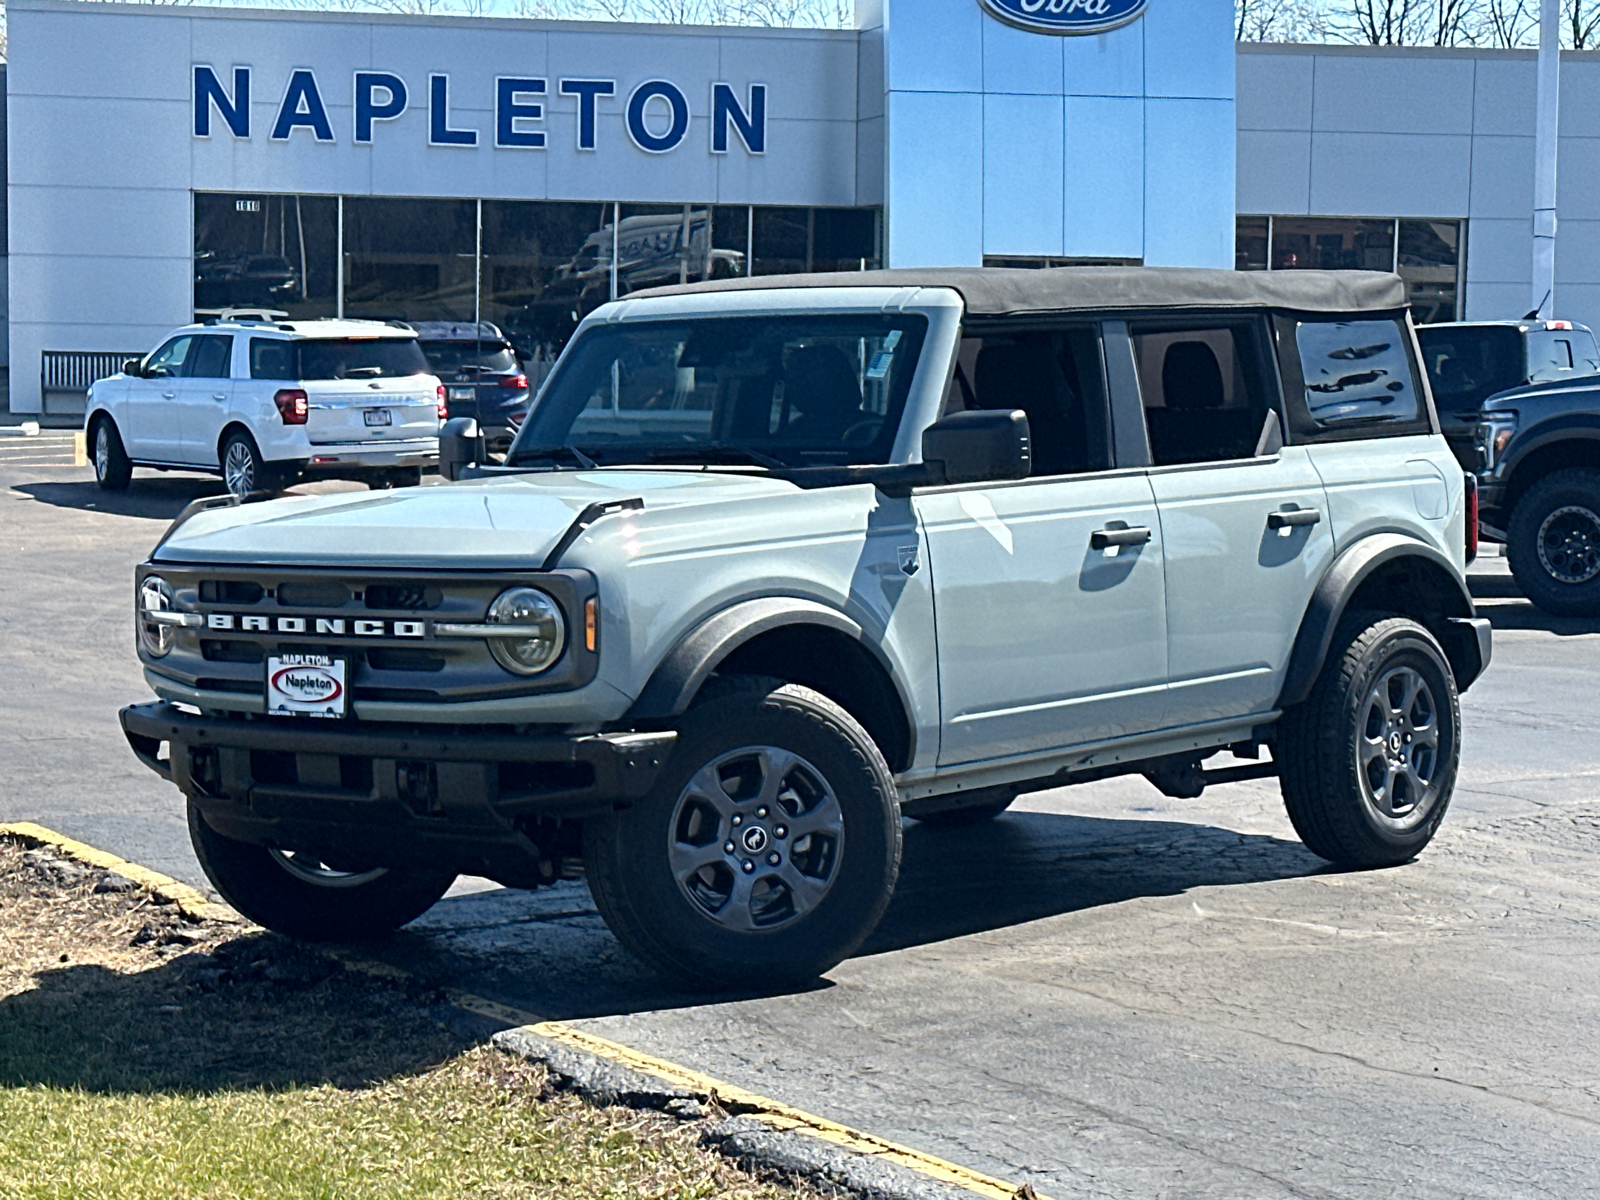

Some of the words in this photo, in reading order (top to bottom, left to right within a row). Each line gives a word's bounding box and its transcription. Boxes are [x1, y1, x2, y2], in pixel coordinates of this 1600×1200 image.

[192, 64, 767, 155] NAPLETON
[207, 614, 425, 637] BRONCO
[282, 654, 329, 665] NAPLETON
[285, 673, 332, 690] Napleton
